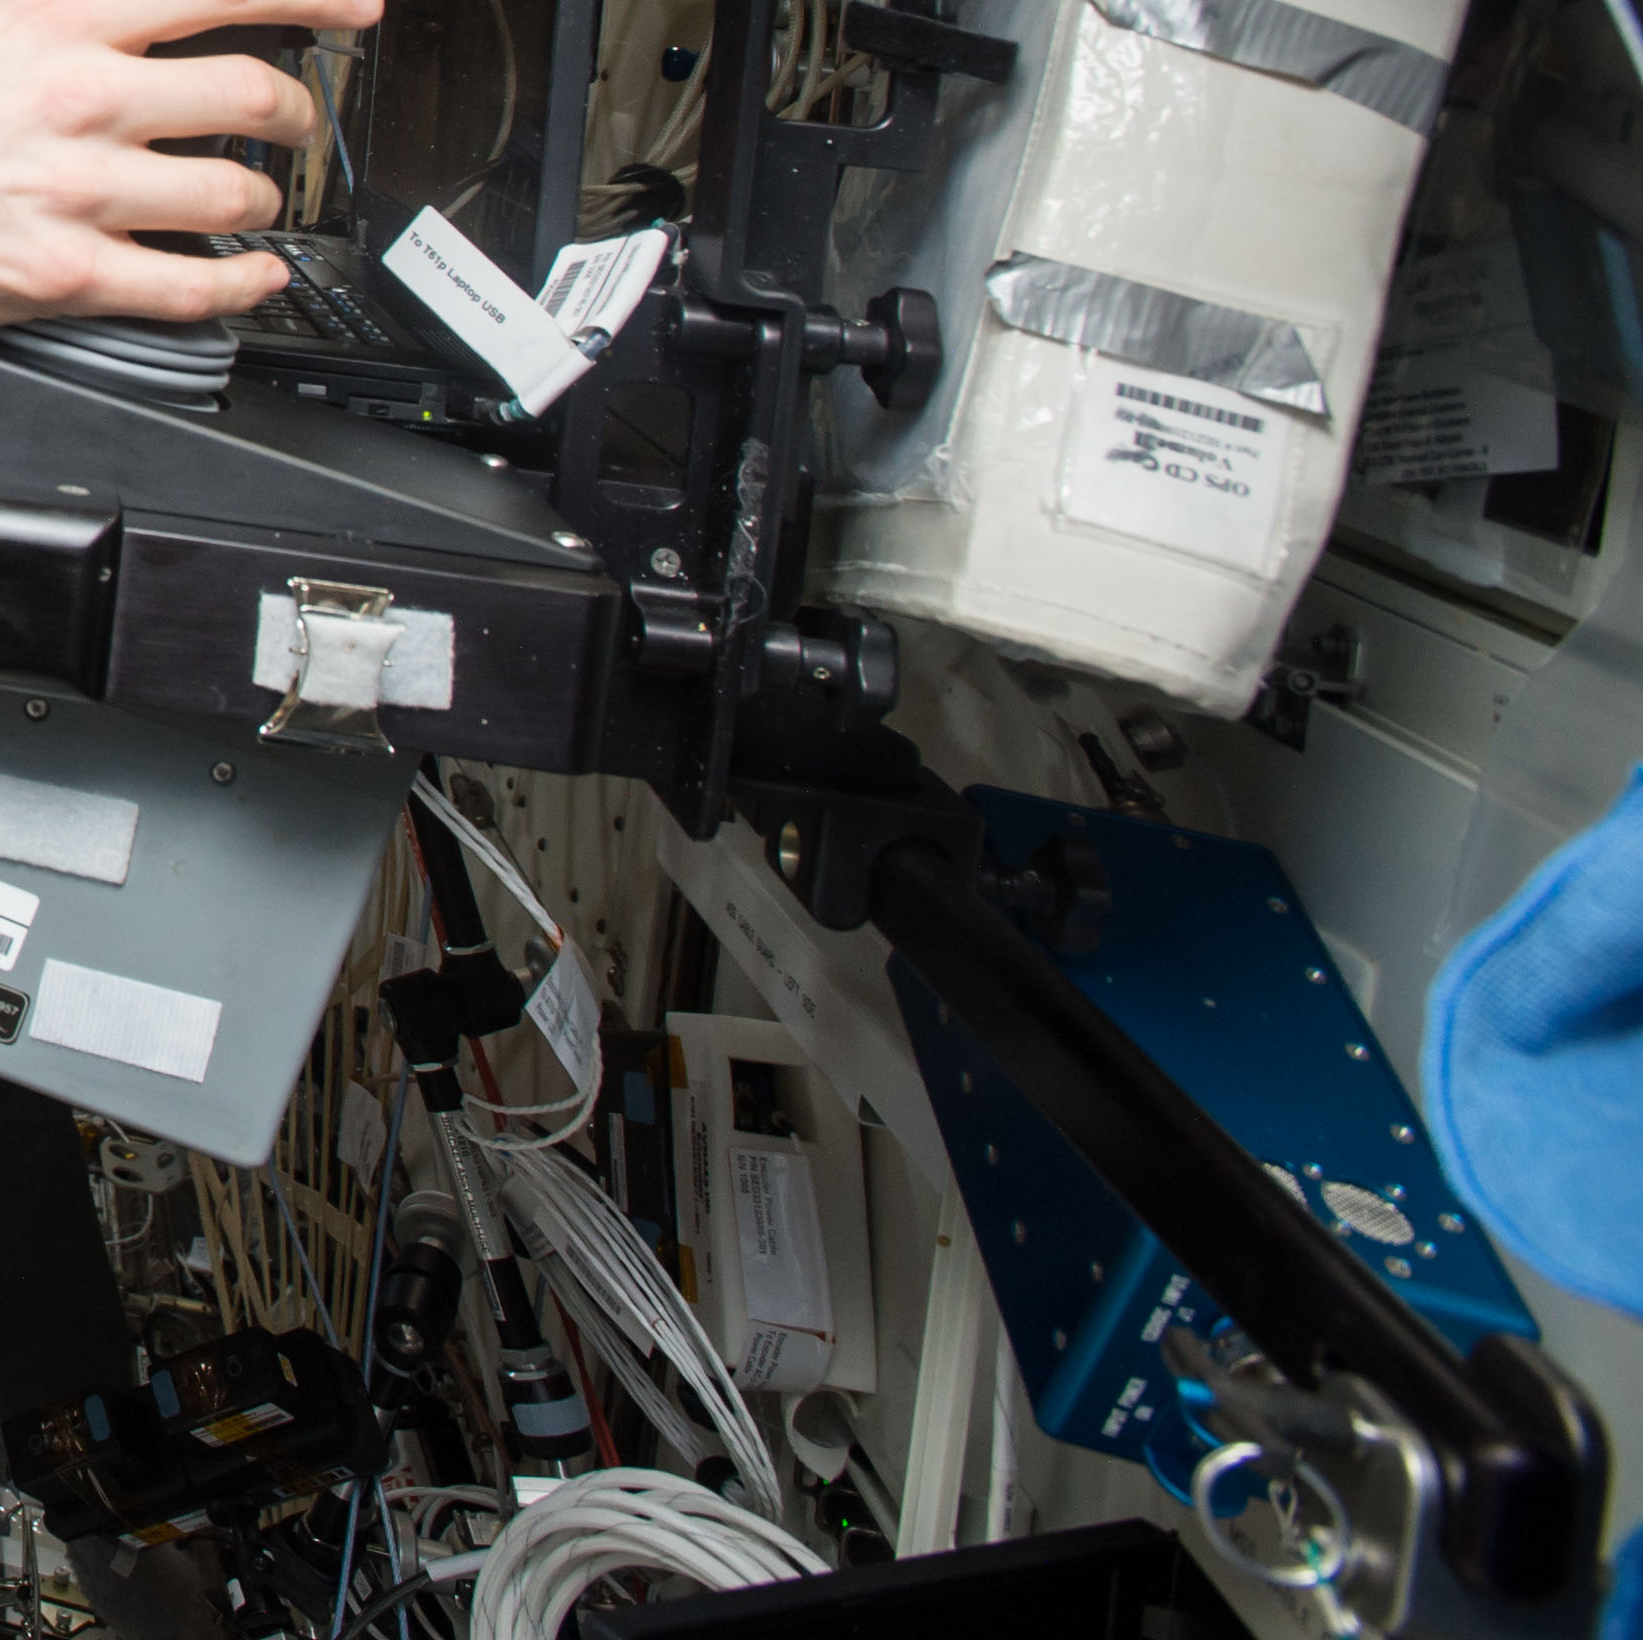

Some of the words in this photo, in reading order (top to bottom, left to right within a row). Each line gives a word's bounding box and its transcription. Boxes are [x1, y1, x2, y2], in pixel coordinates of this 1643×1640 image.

[406, 229, 426, 249] To
[419, 243, 450, 273] T61p
[444, 265, 484, 305] Laptop
[479, 297, 508, 325] USB
[1163, 461, 1199, 483] CD
[1202, 473, 1251, 498] OPS
